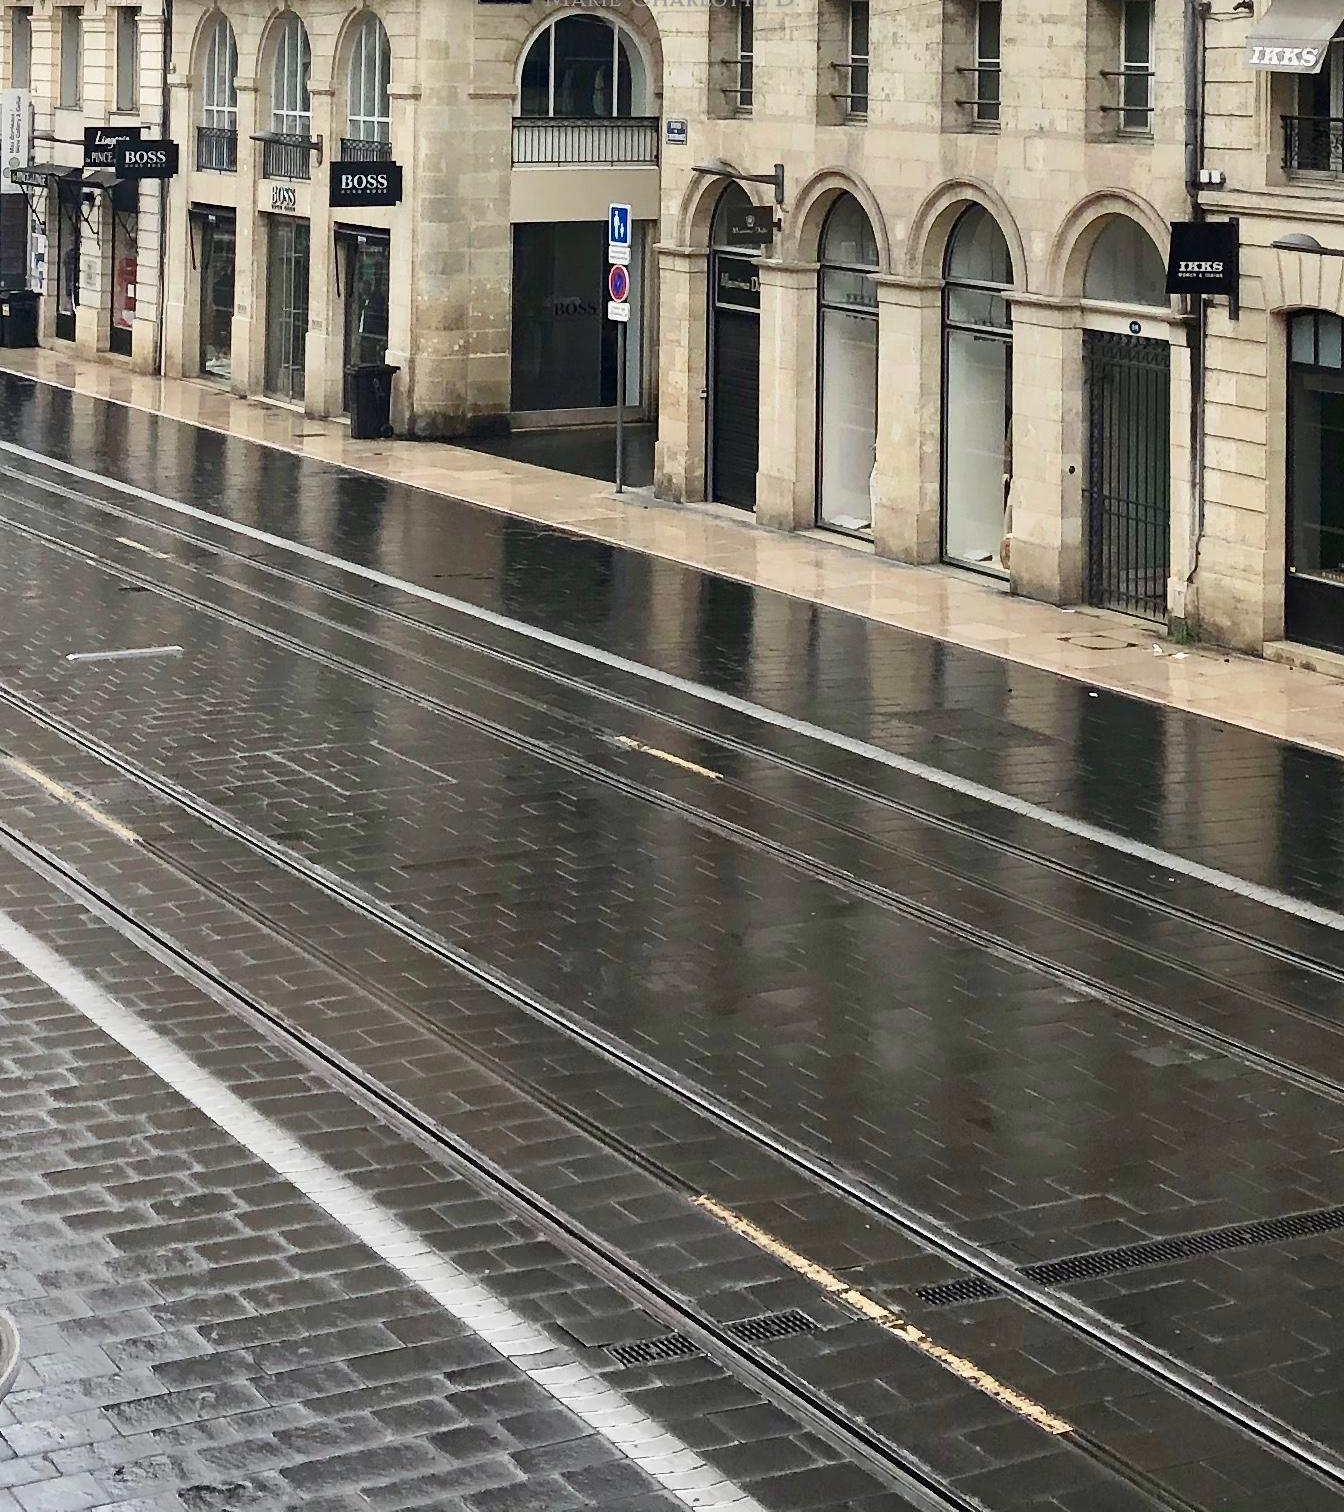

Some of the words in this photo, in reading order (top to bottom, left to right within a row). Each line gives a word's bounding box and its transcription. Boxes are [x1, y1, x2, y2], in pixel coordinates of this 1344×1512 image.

[1249, 46, 1319, 67] IKKS
[125, 150, 166, 164] BOSS
[341, 174, 388, 189] BOSS
[1178, 261, 1224, 272] IKKS
